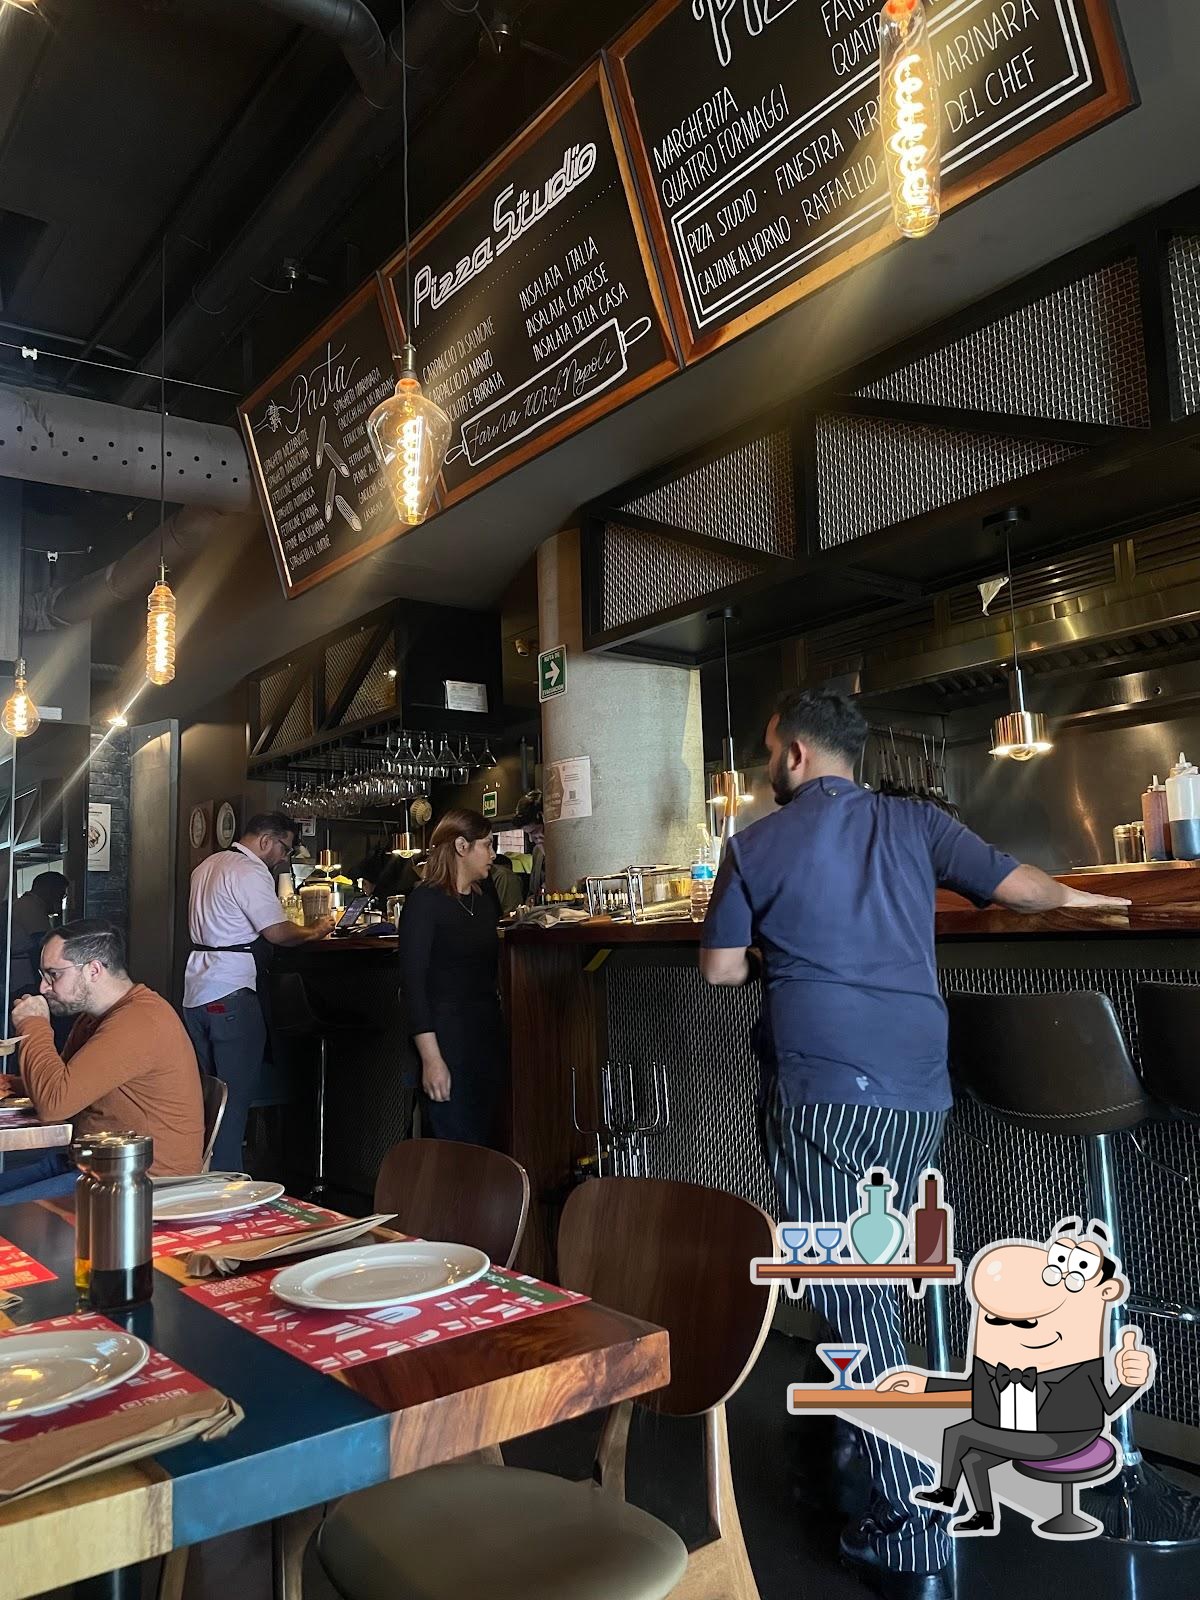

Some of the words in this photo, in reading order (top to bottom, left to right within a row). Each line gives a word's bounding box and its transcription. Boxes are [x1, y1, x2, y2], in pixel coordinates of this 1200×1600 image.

[653, 86, 739, 174] MARGHERITA
[661, 143, 718, 208] QUATTRO
[716, 83, 790, 165] FORMAGGI
[697, 250, 740, 296] CALZONE
[737, 244, 752, 271] AL
[747, 215, 791, 263] HORNO
[800, 154, 877, 227] RAFFAELLO
[944, 87, 985, 133] DEL
[985, 46, 1035, 106] CHEF
[687, 222, 716, 258] PIZZA
[716, 188, 757, 236] STUDIO
[775, 127, 845, 195] FINESTRA
[413, 236, 494, 329] Pizza
[493, 142, 597, 257] Studio
[518, 264, 564, 312] INSALATA
[564, 235, 599, 276] ITALIA
[525, 295, 567, 338] INSALATA
[566, 261, 609, 308] CAPRESE
[532, 321, 574, 362] INSALATA
[571, 304, 600, 335] DELLA
[598, 281, 629, 316] CASA
[285, 341, 361, 435] Pasta
[422, 345, 458, 385] CARPACCIO
[468, 349, 494, 379] MANZO
[472, 370, 506, 405] BURRATA
